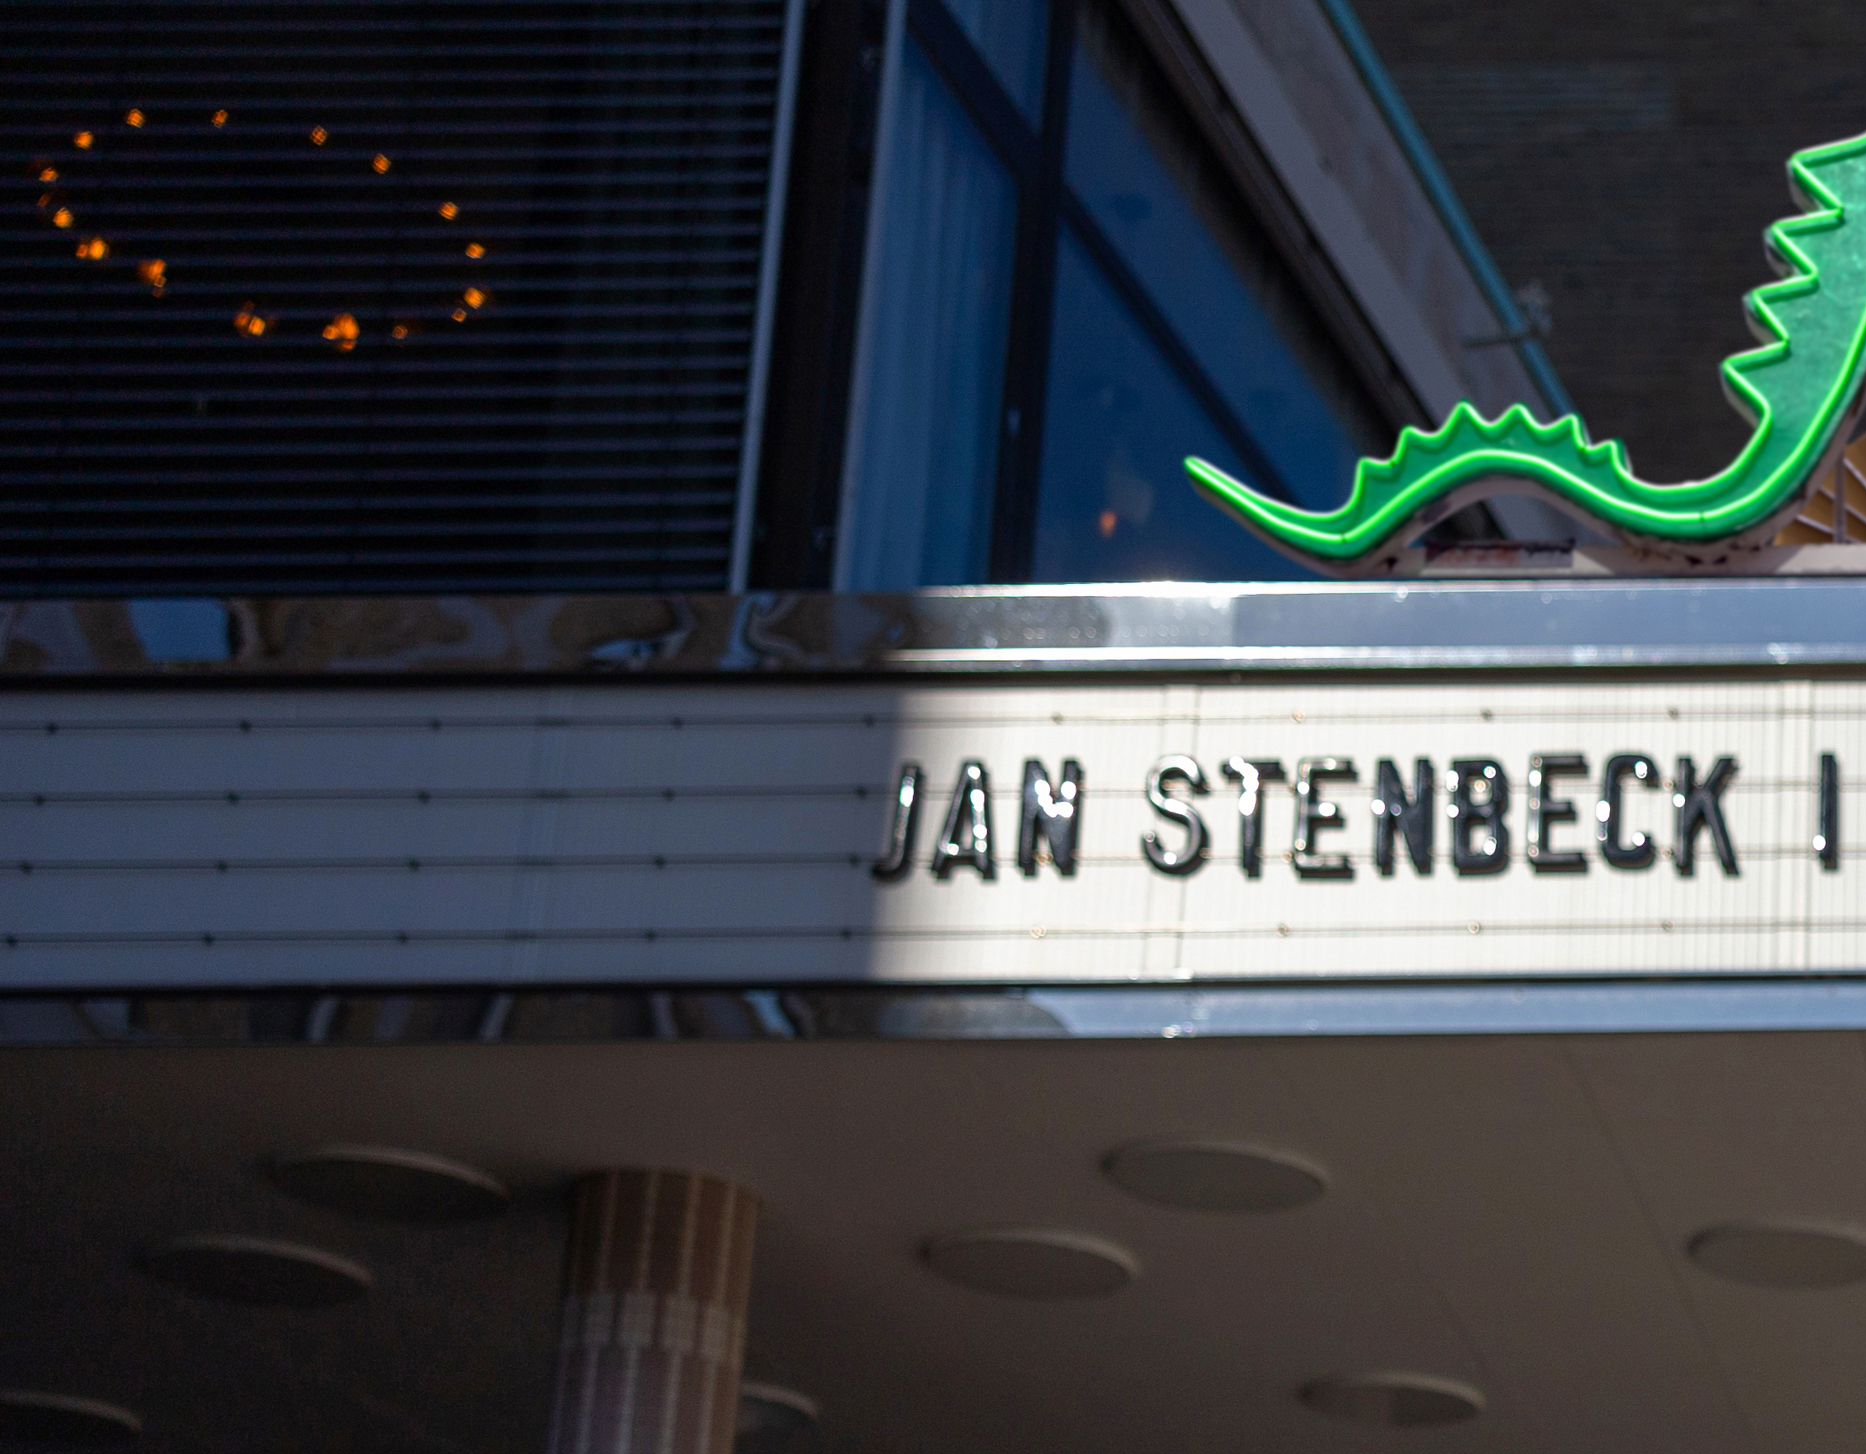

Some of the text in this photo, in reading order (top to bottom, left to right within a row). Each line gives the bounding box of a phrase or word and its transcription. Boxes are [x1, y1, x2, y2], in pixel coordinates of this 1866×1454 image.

[870, 758, 1083, 881] JAN
[1140, 753, 1741, 880] STENBECK
[1816, 753, 1840, 870] I
